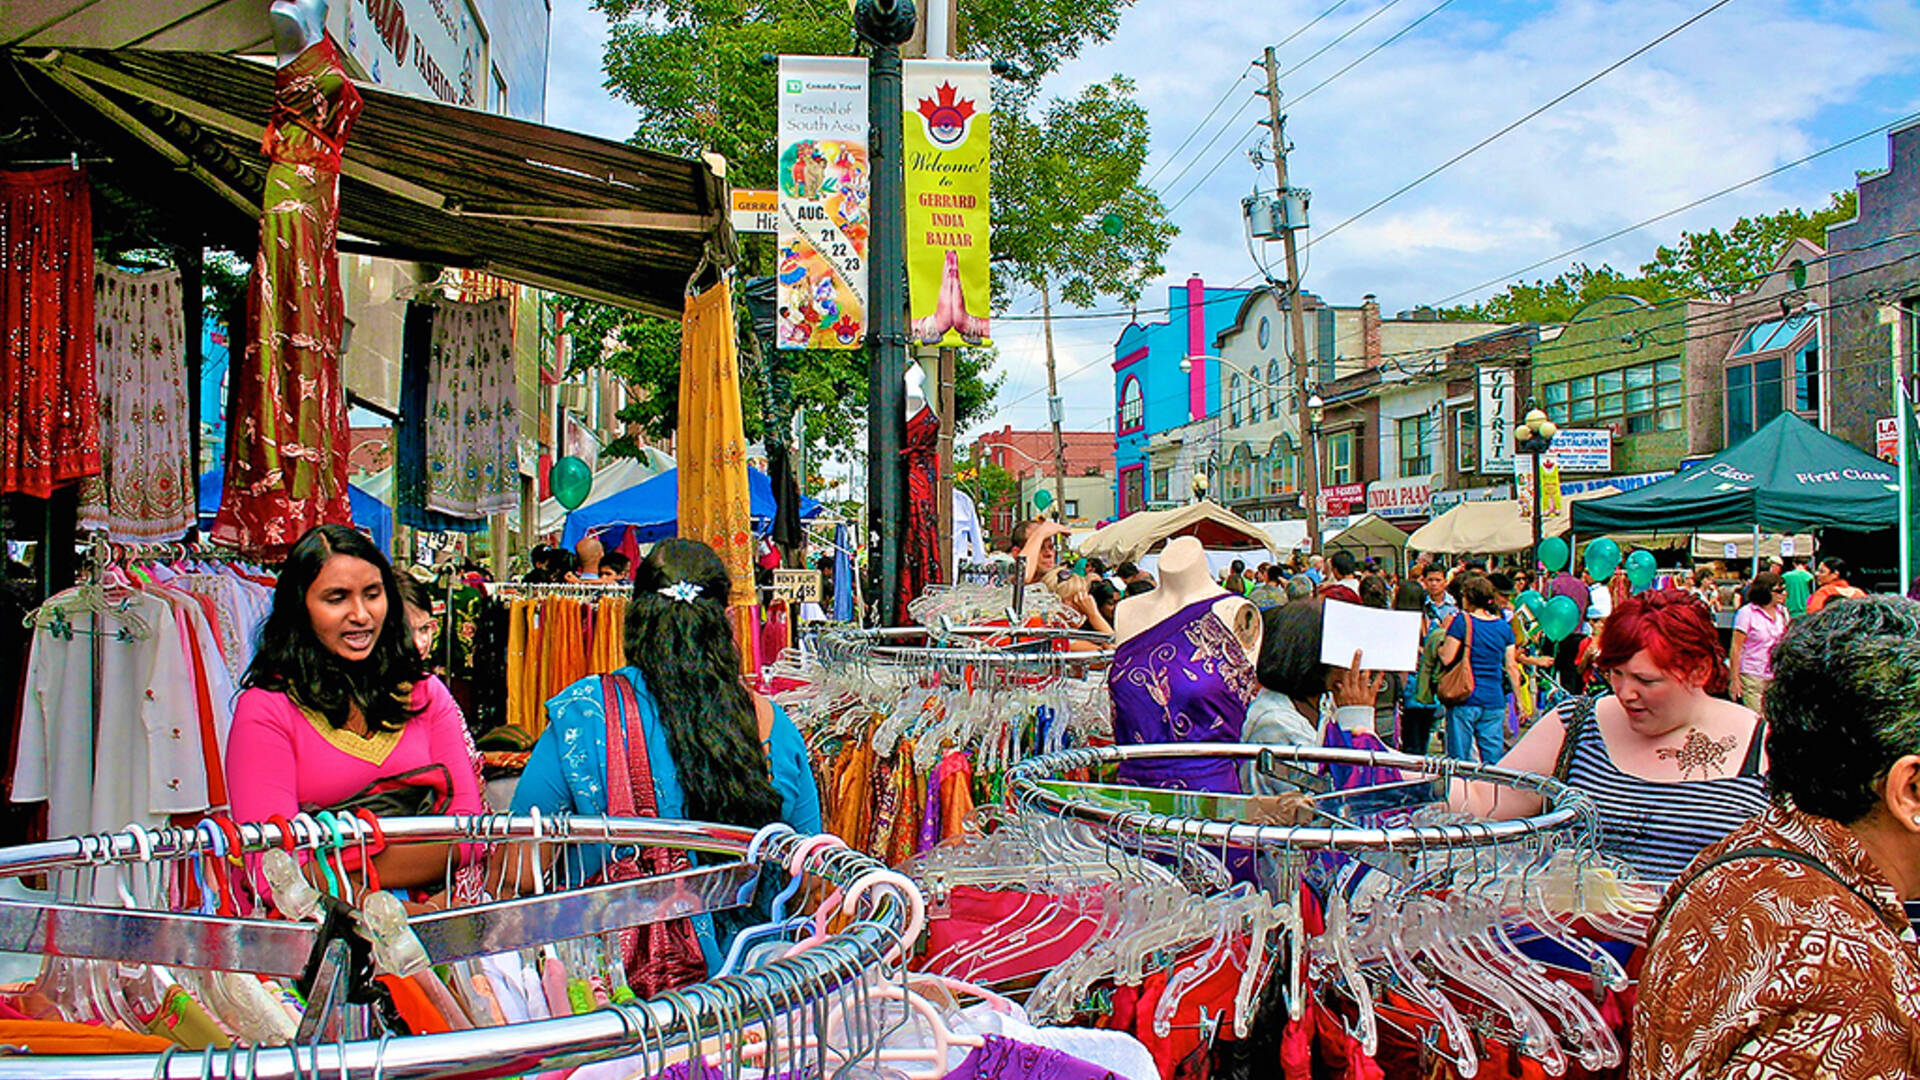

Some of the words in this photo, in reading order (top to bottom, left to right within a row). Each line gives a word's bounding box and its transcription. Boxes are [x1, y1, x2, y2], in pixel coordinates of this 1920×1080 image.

[793, 103, 837, 114] Festival
[838, 101, 852, 114] of
[787, 116, 828, 131] South
[830, 120, 862, 133] Asia
[910, 152, 984, 173] Welcome!
[939, 176, 953, 187] to
[738, 202, 778, 210] GERRA
[919, 192, 976, 209] GERRARD
[798, 206, 829, 220] AUG.
[932, 213, 965, 228] INDIA
[821, 229, 835, 242] 21
[926, 232, 973, 248] BAZAAR
[832, 243, 847, 257] 22
[844, 258, 860, 271] 23
[1795, 470, 1839, 484] First
[1842, 468, 1891, 481] Class
[1368, 488, 1398, 508] INDIA
